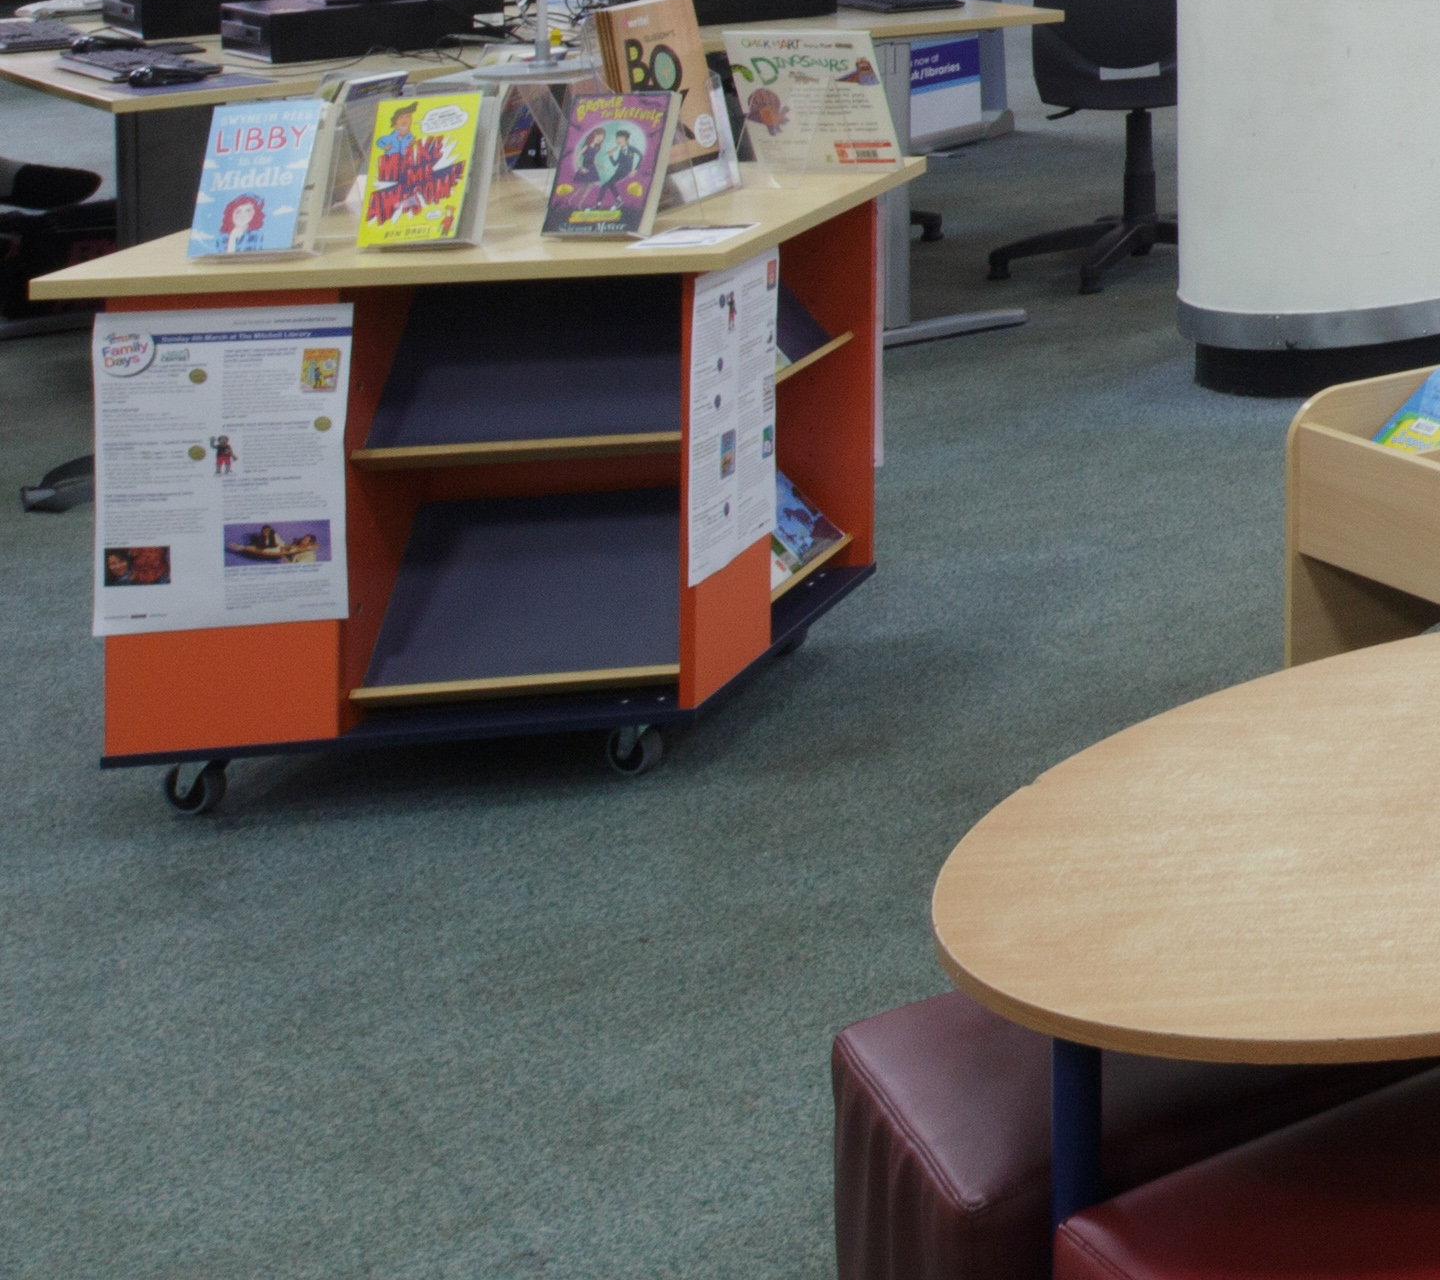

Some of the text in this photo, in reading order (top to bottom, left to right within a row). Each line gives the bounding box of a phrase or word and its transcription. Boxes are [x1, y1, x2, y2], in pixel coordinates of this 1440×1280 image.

[914, 55, 931, 66] now
[750, 55, 849, 86] DINOSAURS
[219, 111, 313, 126] GWYNETH REES
[215, 125, 309, 155] LIBBY
[253, 154, 273, 166] the
[378, 135, 444, 182] MAKE
[211, 167, 294, 191] Middle
[405, 162, 434, 187] ME
[384, 225, 432, 240] BEN DAVIS
[102, 341, 148, 358] Family
[104, 353, 141, 368] Days
